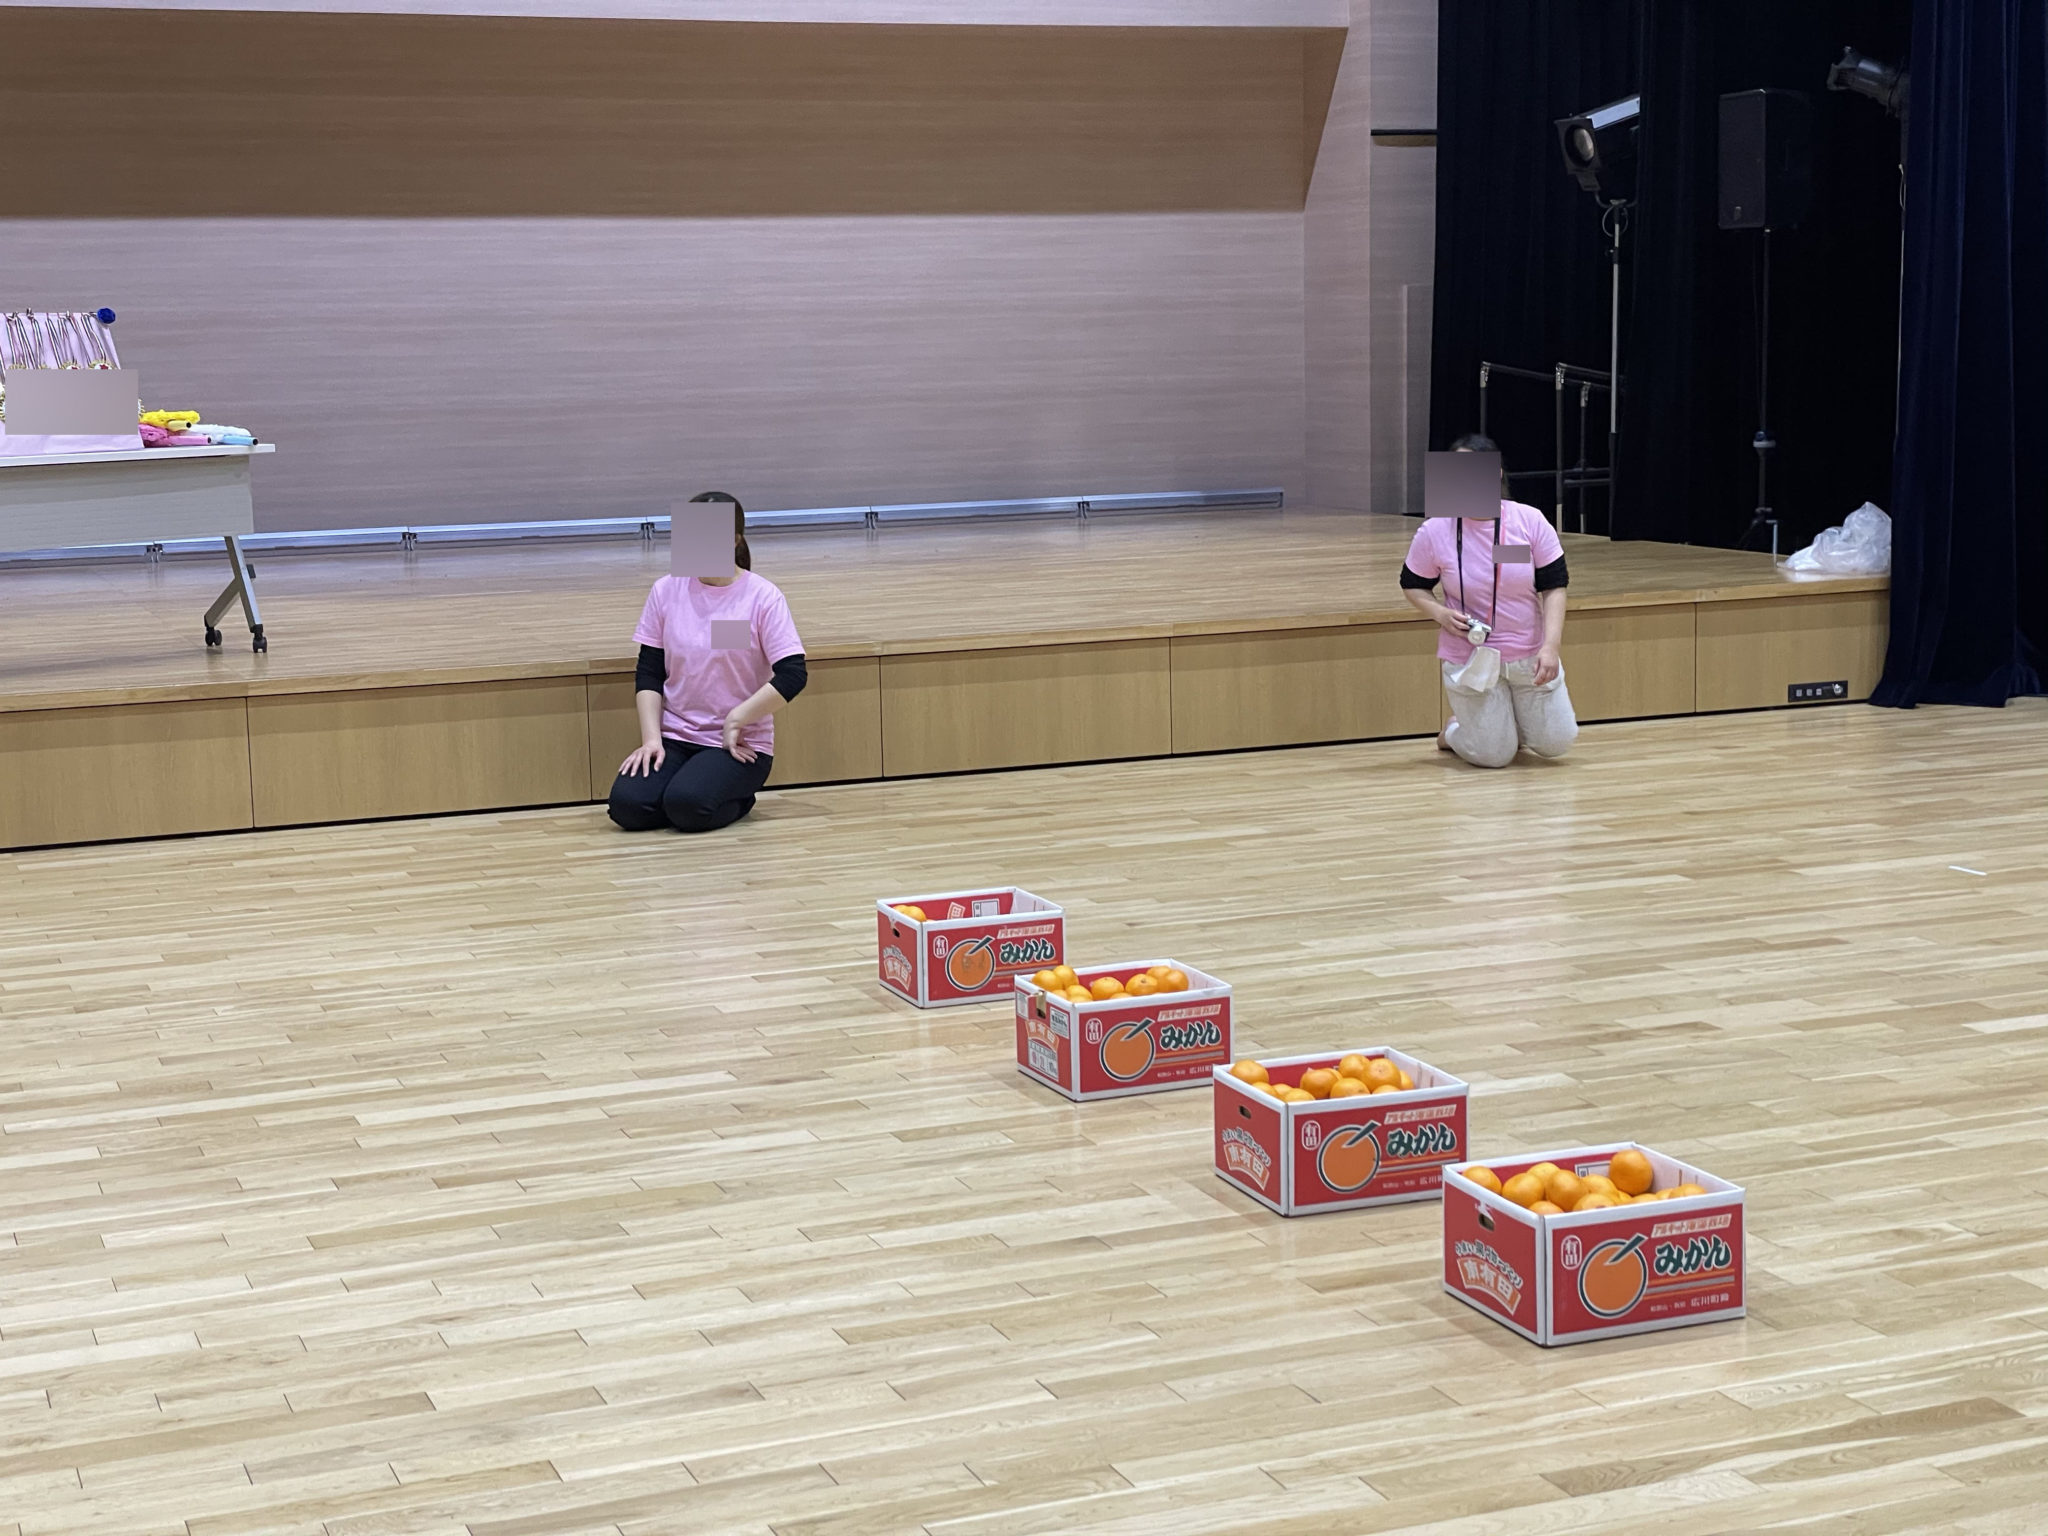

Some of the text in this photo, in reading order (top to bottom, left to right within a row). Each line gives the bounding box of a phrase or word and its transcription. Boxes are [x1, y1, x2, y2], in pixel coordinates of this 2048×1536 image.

[999, 938, 1055, 965] みかん
[1160, 1019, 1222, 1051] みかん
[1386, 1122, 1457, 1158] みかん
[1654, 1234, 1732, 1276] みかん
